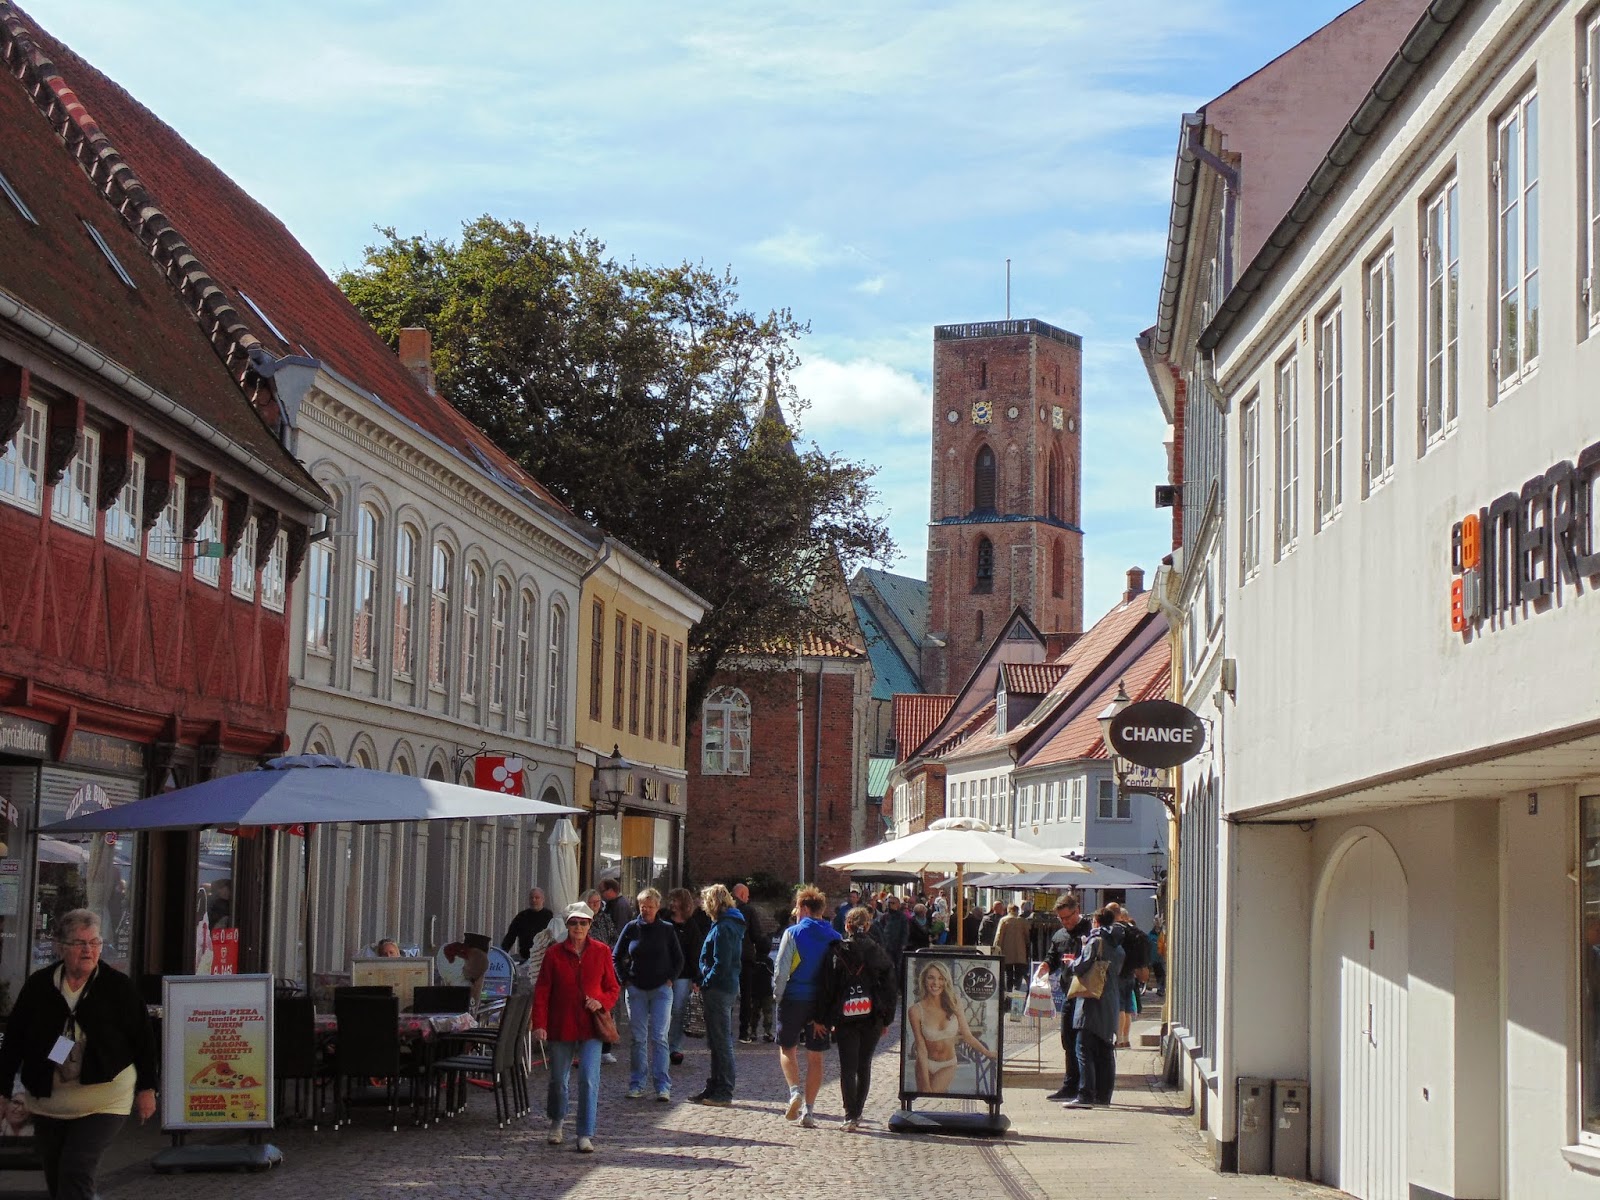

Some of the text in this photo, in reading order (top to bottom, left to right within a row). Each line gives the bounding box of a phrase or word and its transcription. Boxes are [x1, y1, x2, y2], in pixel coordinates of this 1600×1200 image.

[1121, 726, 1193, 743] CHANGE
[967, 971, 976, 988] 3
[984, 972, 994, 988] 2
